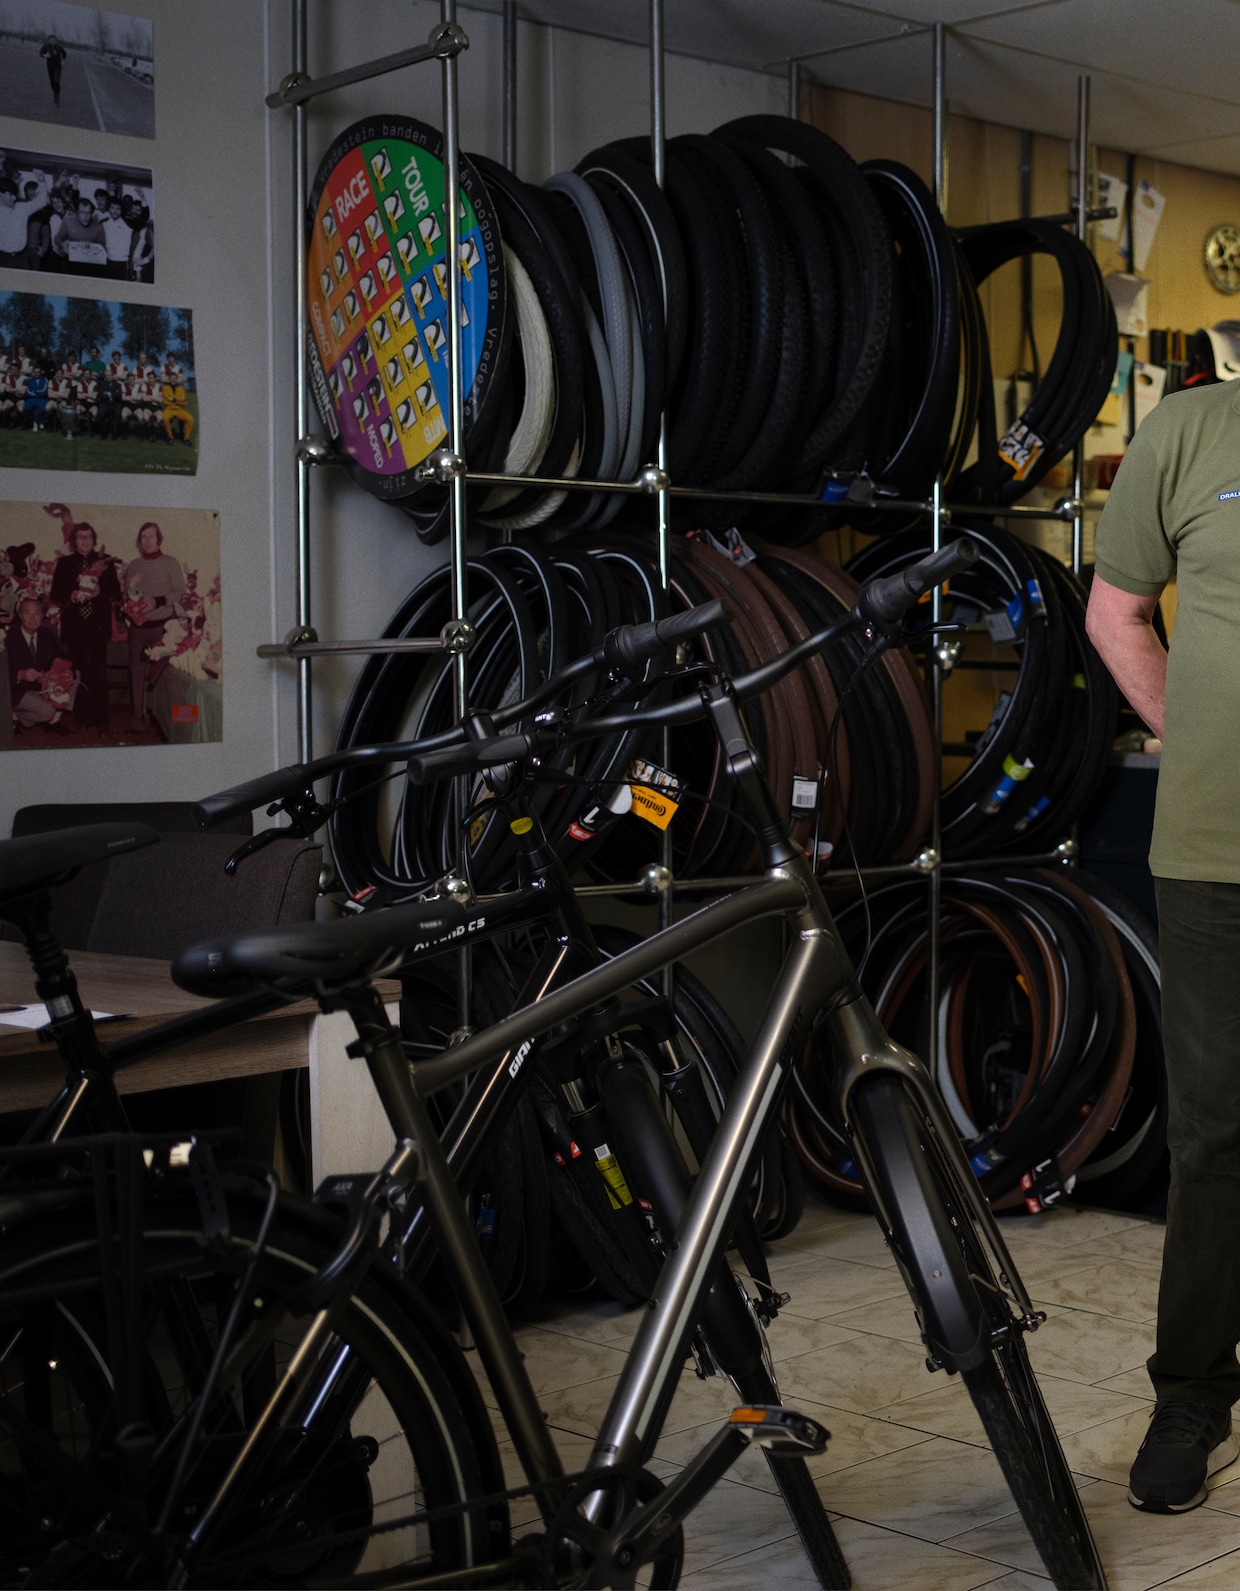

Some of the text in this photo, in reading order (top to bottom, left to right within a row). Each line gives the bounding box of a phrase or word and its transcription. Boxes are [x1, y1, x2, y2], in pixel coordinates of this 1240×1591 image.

[382, 122, 428, 145] banden
[335, 169, 370, 223] RACE
[401, 155, 429, 217] TOUR
[312, 301, 331, 357] COMPACT
[308, 331, 331, 412] REDESTEIN
[464, 327, 498, 418] Vredeste
[367, 423, 384, 469] MOPED
[423, 415, 448, 445] MTB
[632, 792, 667, 817] Contine
[467, 916, 486, 932] CS
[508, 1037, 536, 1079] GIA
